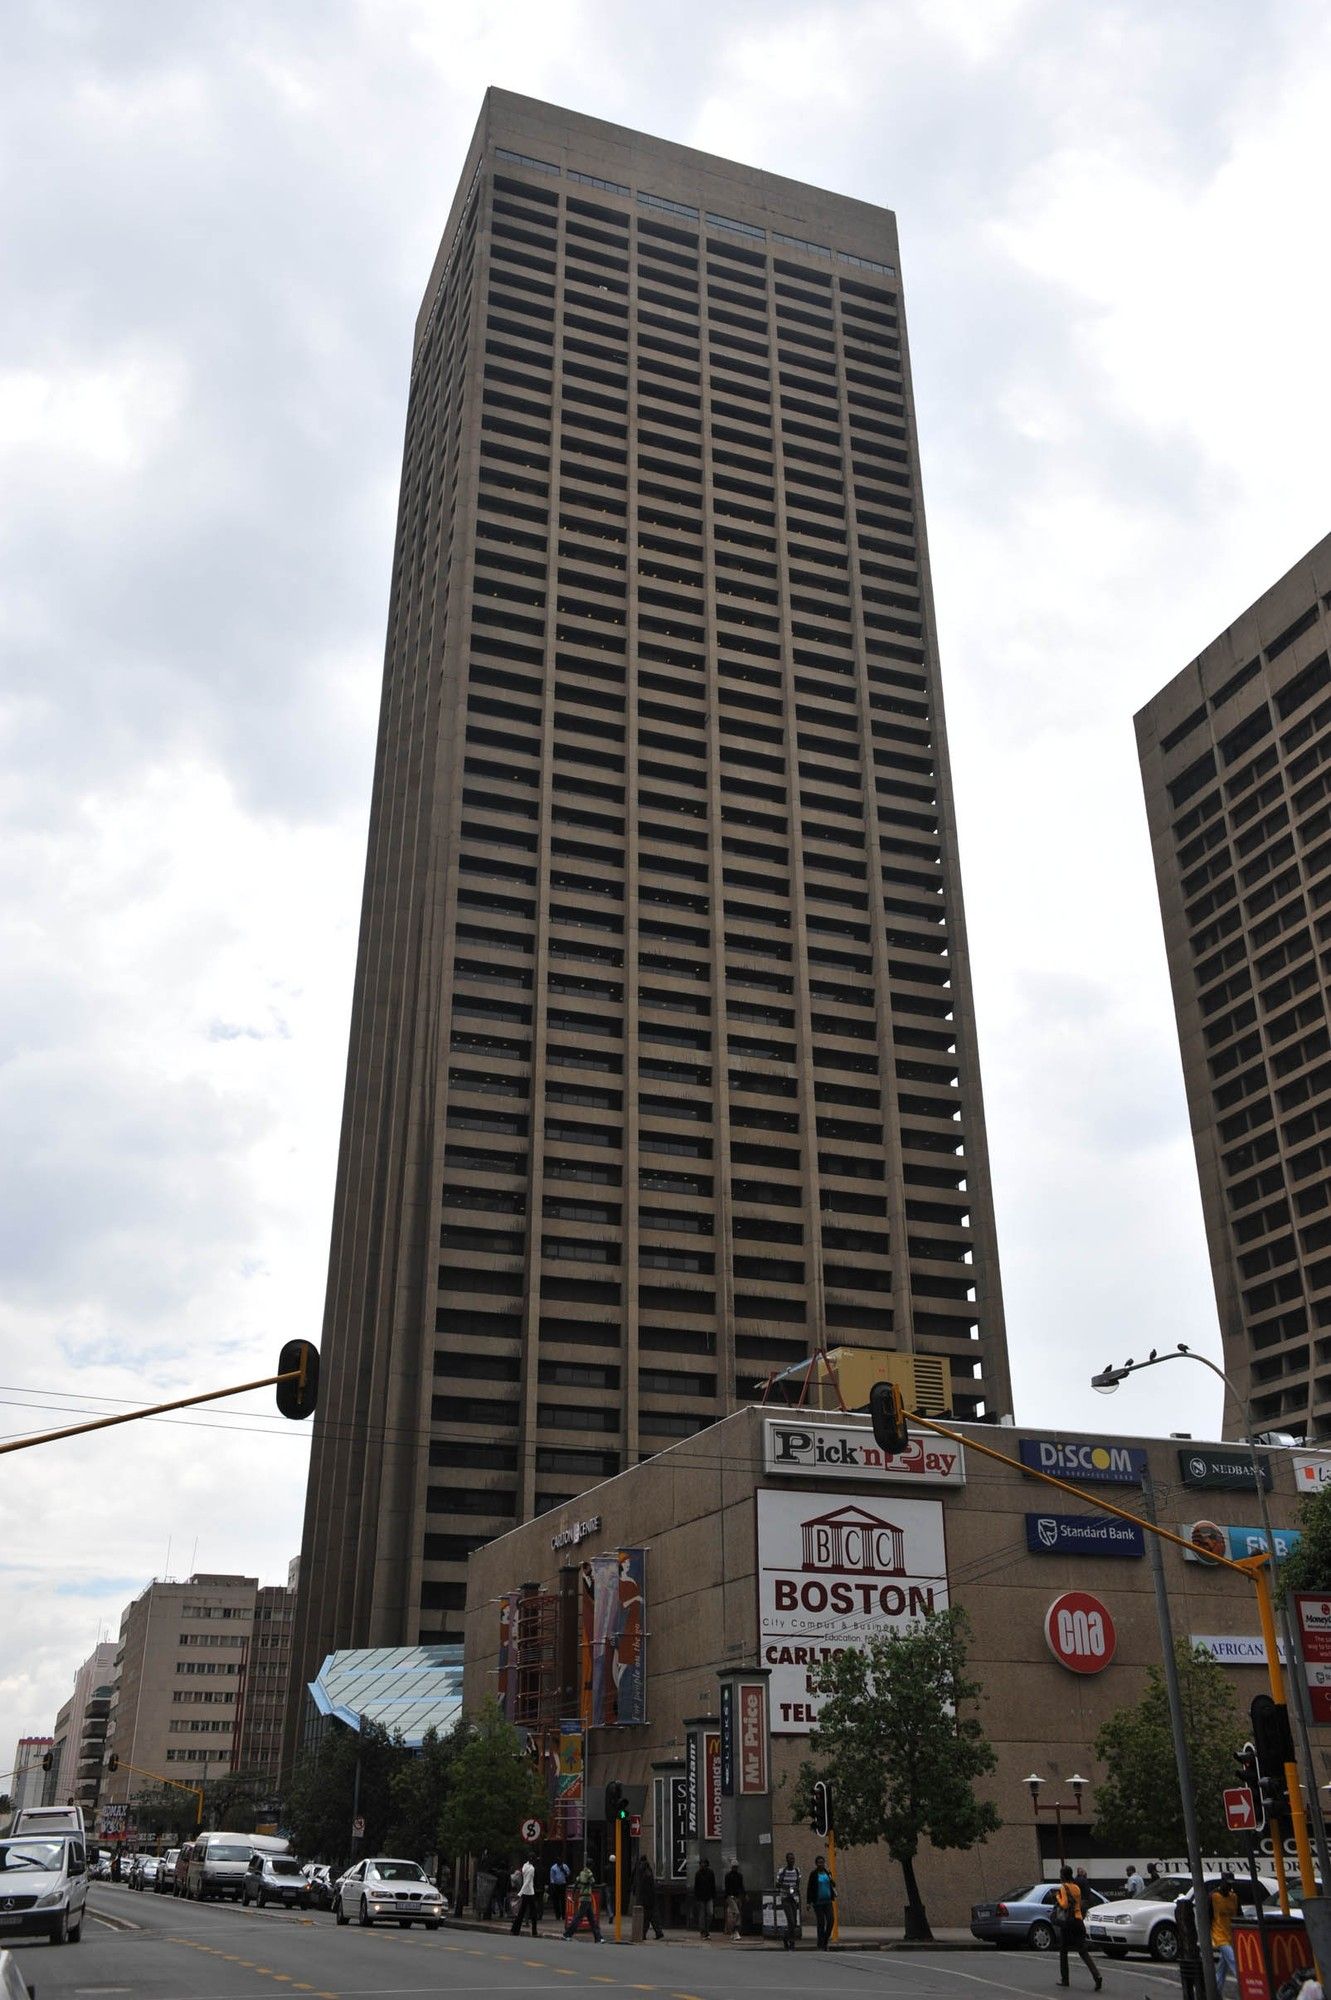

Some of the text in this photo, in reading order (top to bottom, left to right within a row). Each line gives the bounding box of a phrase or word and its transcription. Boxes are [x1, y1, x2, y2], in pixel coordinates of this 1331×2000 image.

[776, 1431, 859, 1464] Pick
[886, 1438, 956, 1476] Pay
[1060, 1525, 1135, 1540] Standard Bank
[775, 1579, 934, 1617] BOSTON
[762, 1618, 785, 1628] City
[765, 1646, 865, 1665] CARLTO
[1211, 1642, 1264, 1656] AFRICAN
[743, 1694, 760, 1784] Mr Price
[688, 1742, 697, 1833] Markham
[1205, 1861, 1262, 1873] VIEWS
